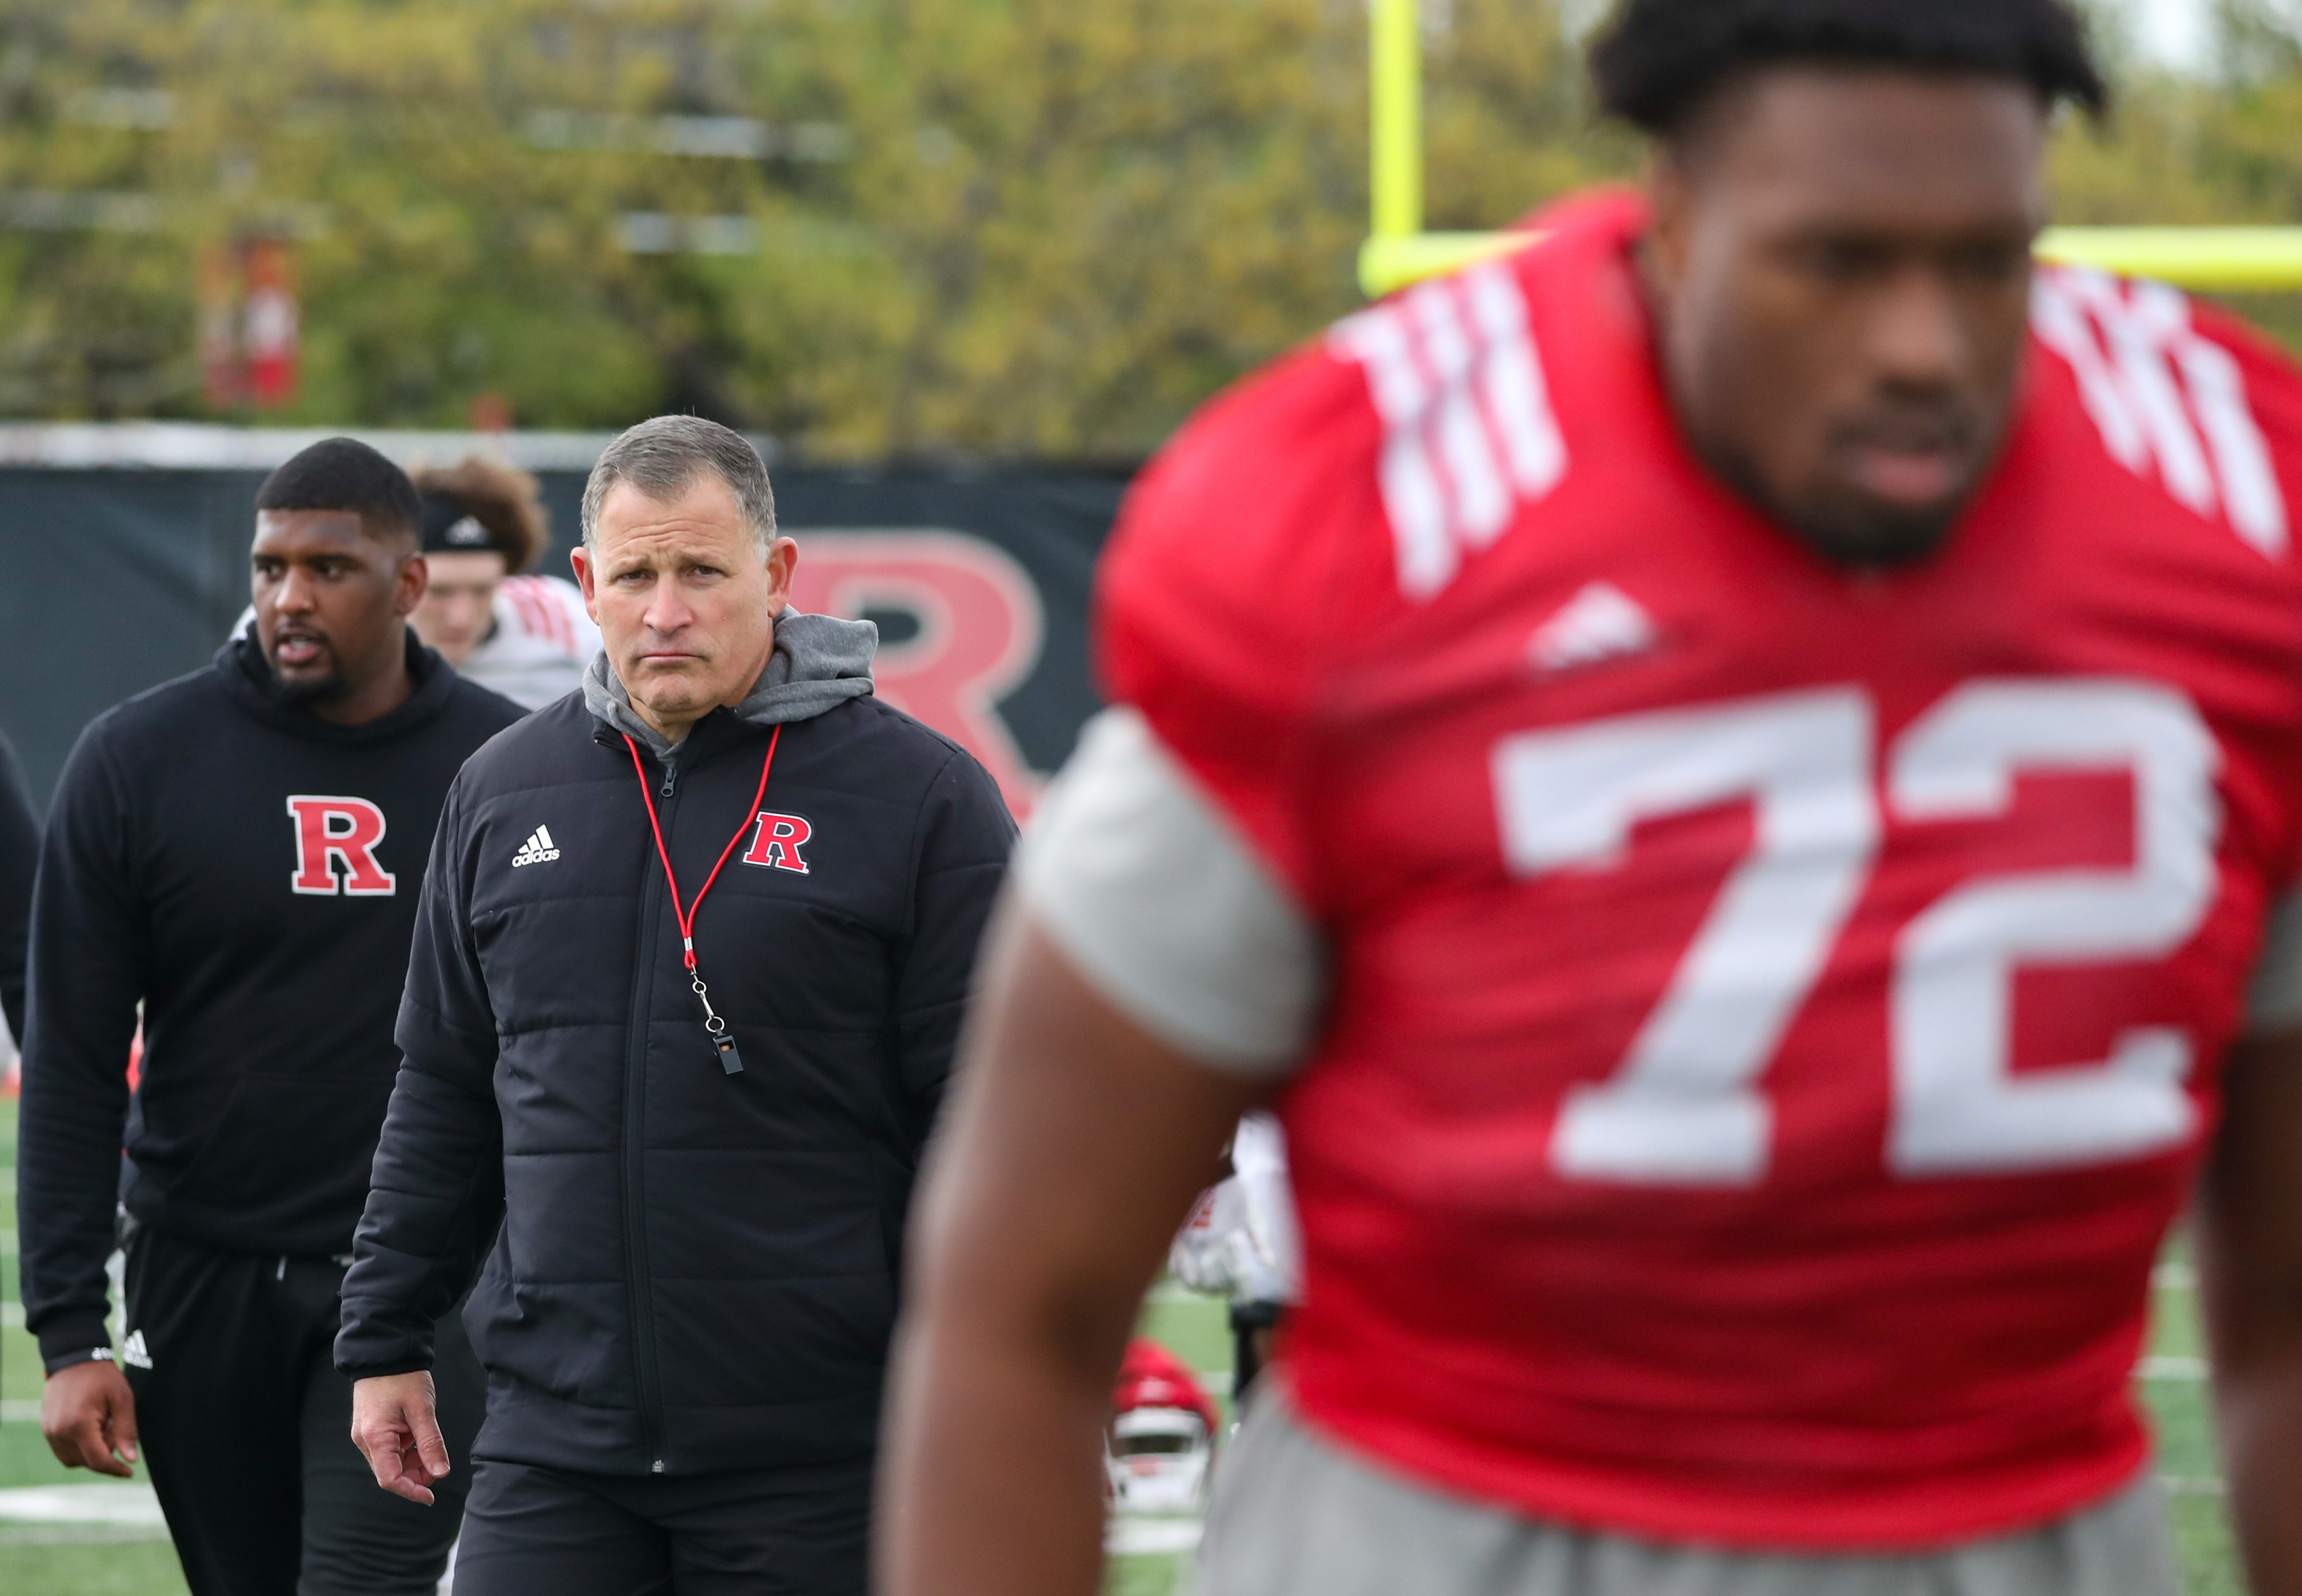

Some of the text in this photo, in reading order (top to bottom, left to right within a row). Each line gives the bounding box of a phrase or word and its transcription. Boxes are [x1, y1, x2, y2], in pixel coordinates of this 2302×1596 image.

[790, 528, 1048, 831] R
[287, 794, 395, 896] R
[511, 848, 560, 868] adidas
[742, 811, 812, 874] R
[1493, 676, 2222, 1188] 72
